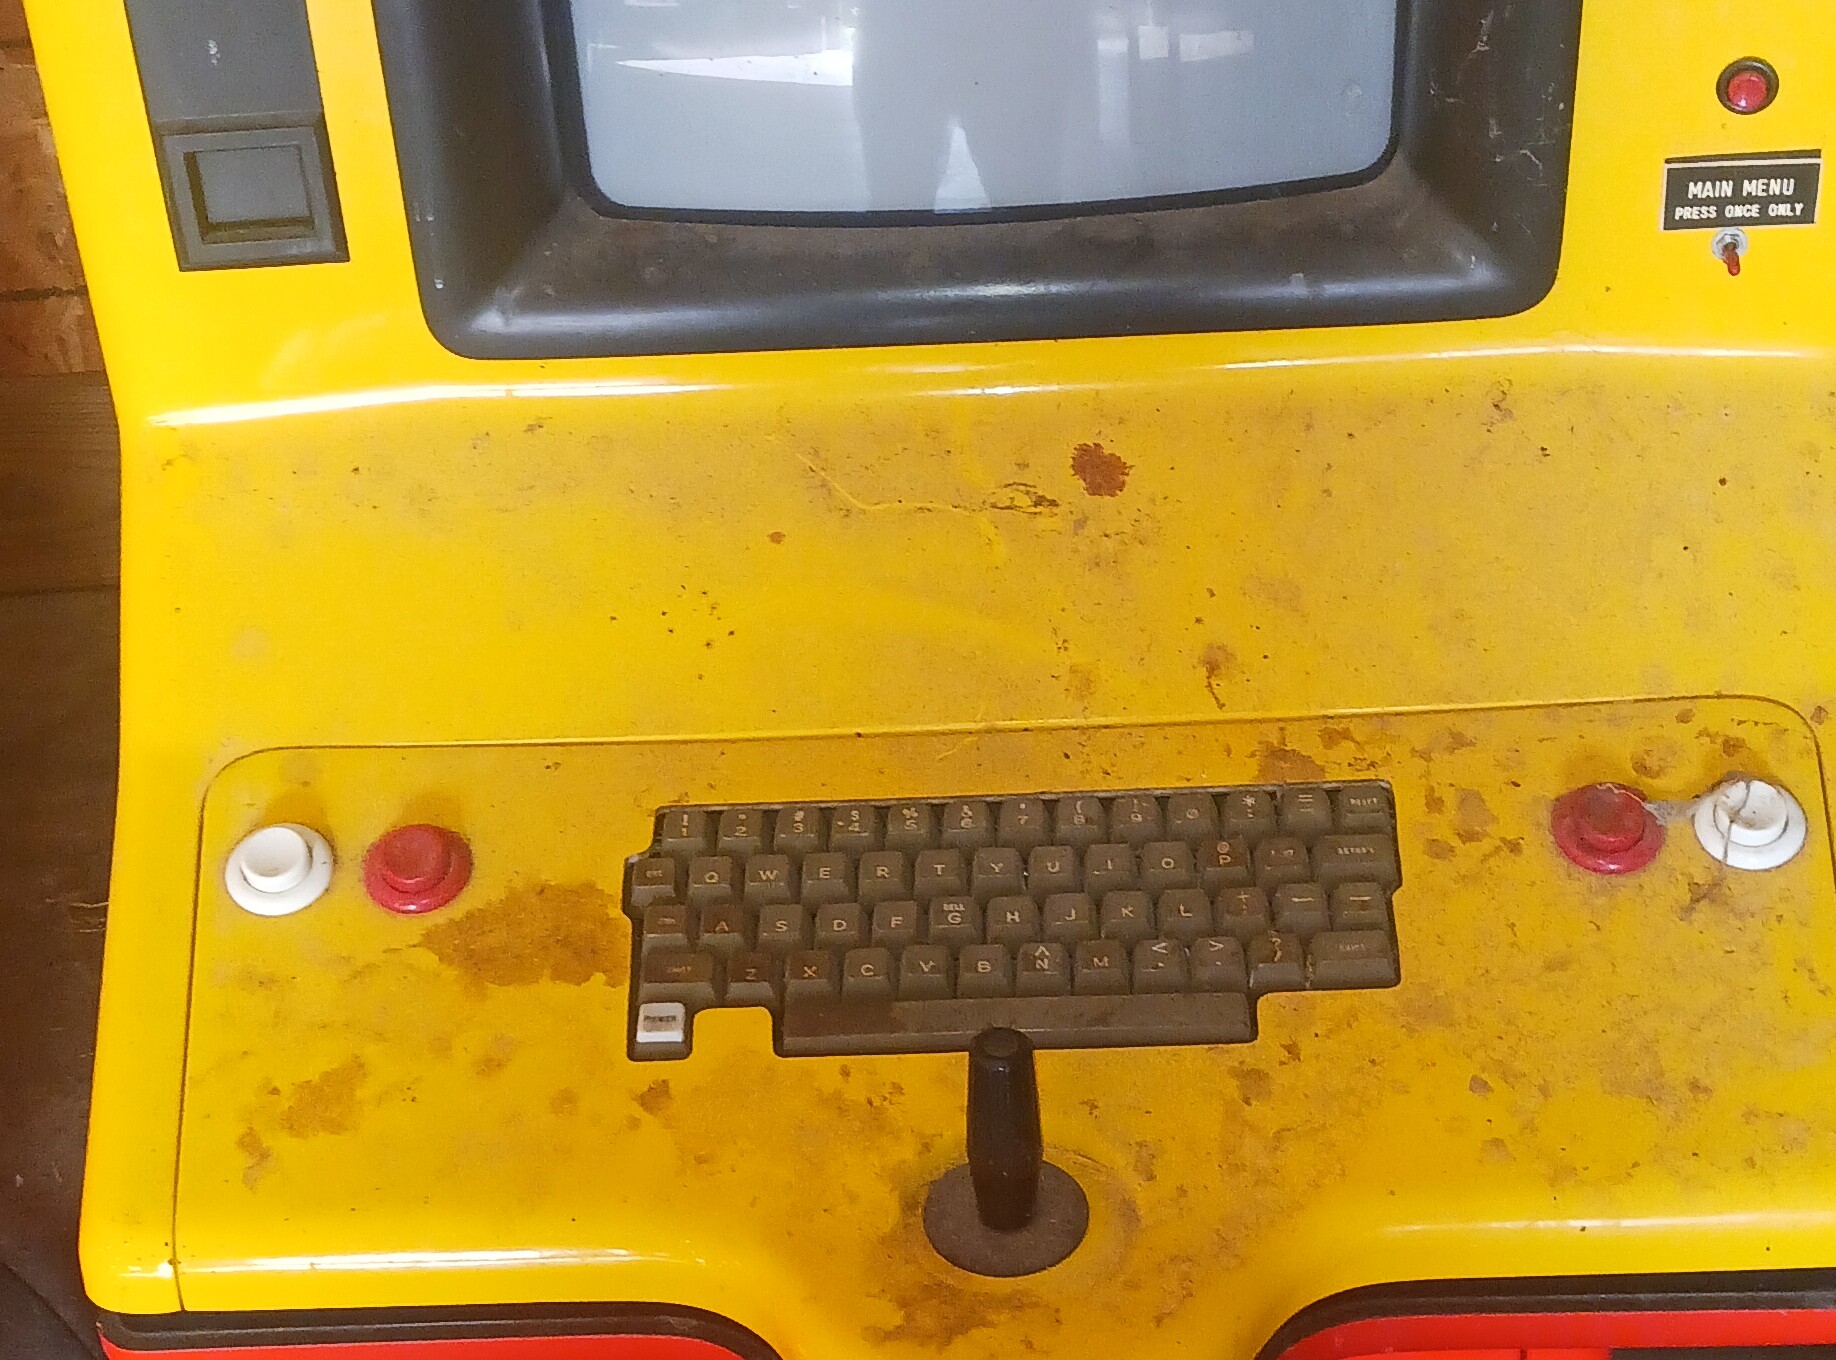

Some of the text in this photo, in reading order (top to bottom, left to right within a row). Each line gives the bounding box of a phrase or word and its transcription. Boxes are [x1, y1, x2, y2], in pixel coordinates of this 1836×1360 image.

[1687, 178, 1795, 200] MAIN MENU
[1674, 202, 1804, 221] PRESS ONCE ONLY
[734, 826, 748, 837] 2
[793, 822, 805, 833] 3
[848, 822, 861, 832] 4
[903, 819, 918, 831] 5
[1073, 814, 1086, 826] 8
[1130, 813, 1143, 823] 9
[704, 871, 719, 884] Q
[758, 869, 779, 881] W
[819, 867, 831, 879] E
[876, 866, 890, 879] R
[933, 864, 946, 876] T
[990, 862, 1003, 874] Y
[1047, 860, 1060, 874] U
[1161, 857, 1175, 870] O
[1219, 854, 1232, 866] P
[714, 903, 1193, 932] A S D F G H J K L
[745, 968, 758, 981] Z
[802, 966, 818, 978] X
[860, 964, 874, 976] C
[919, 960, 936, 972] V
[976, 960, 992, 973] B
[1035, 958, 1049, 970] N
[1092, 955, 1109, 968] M
